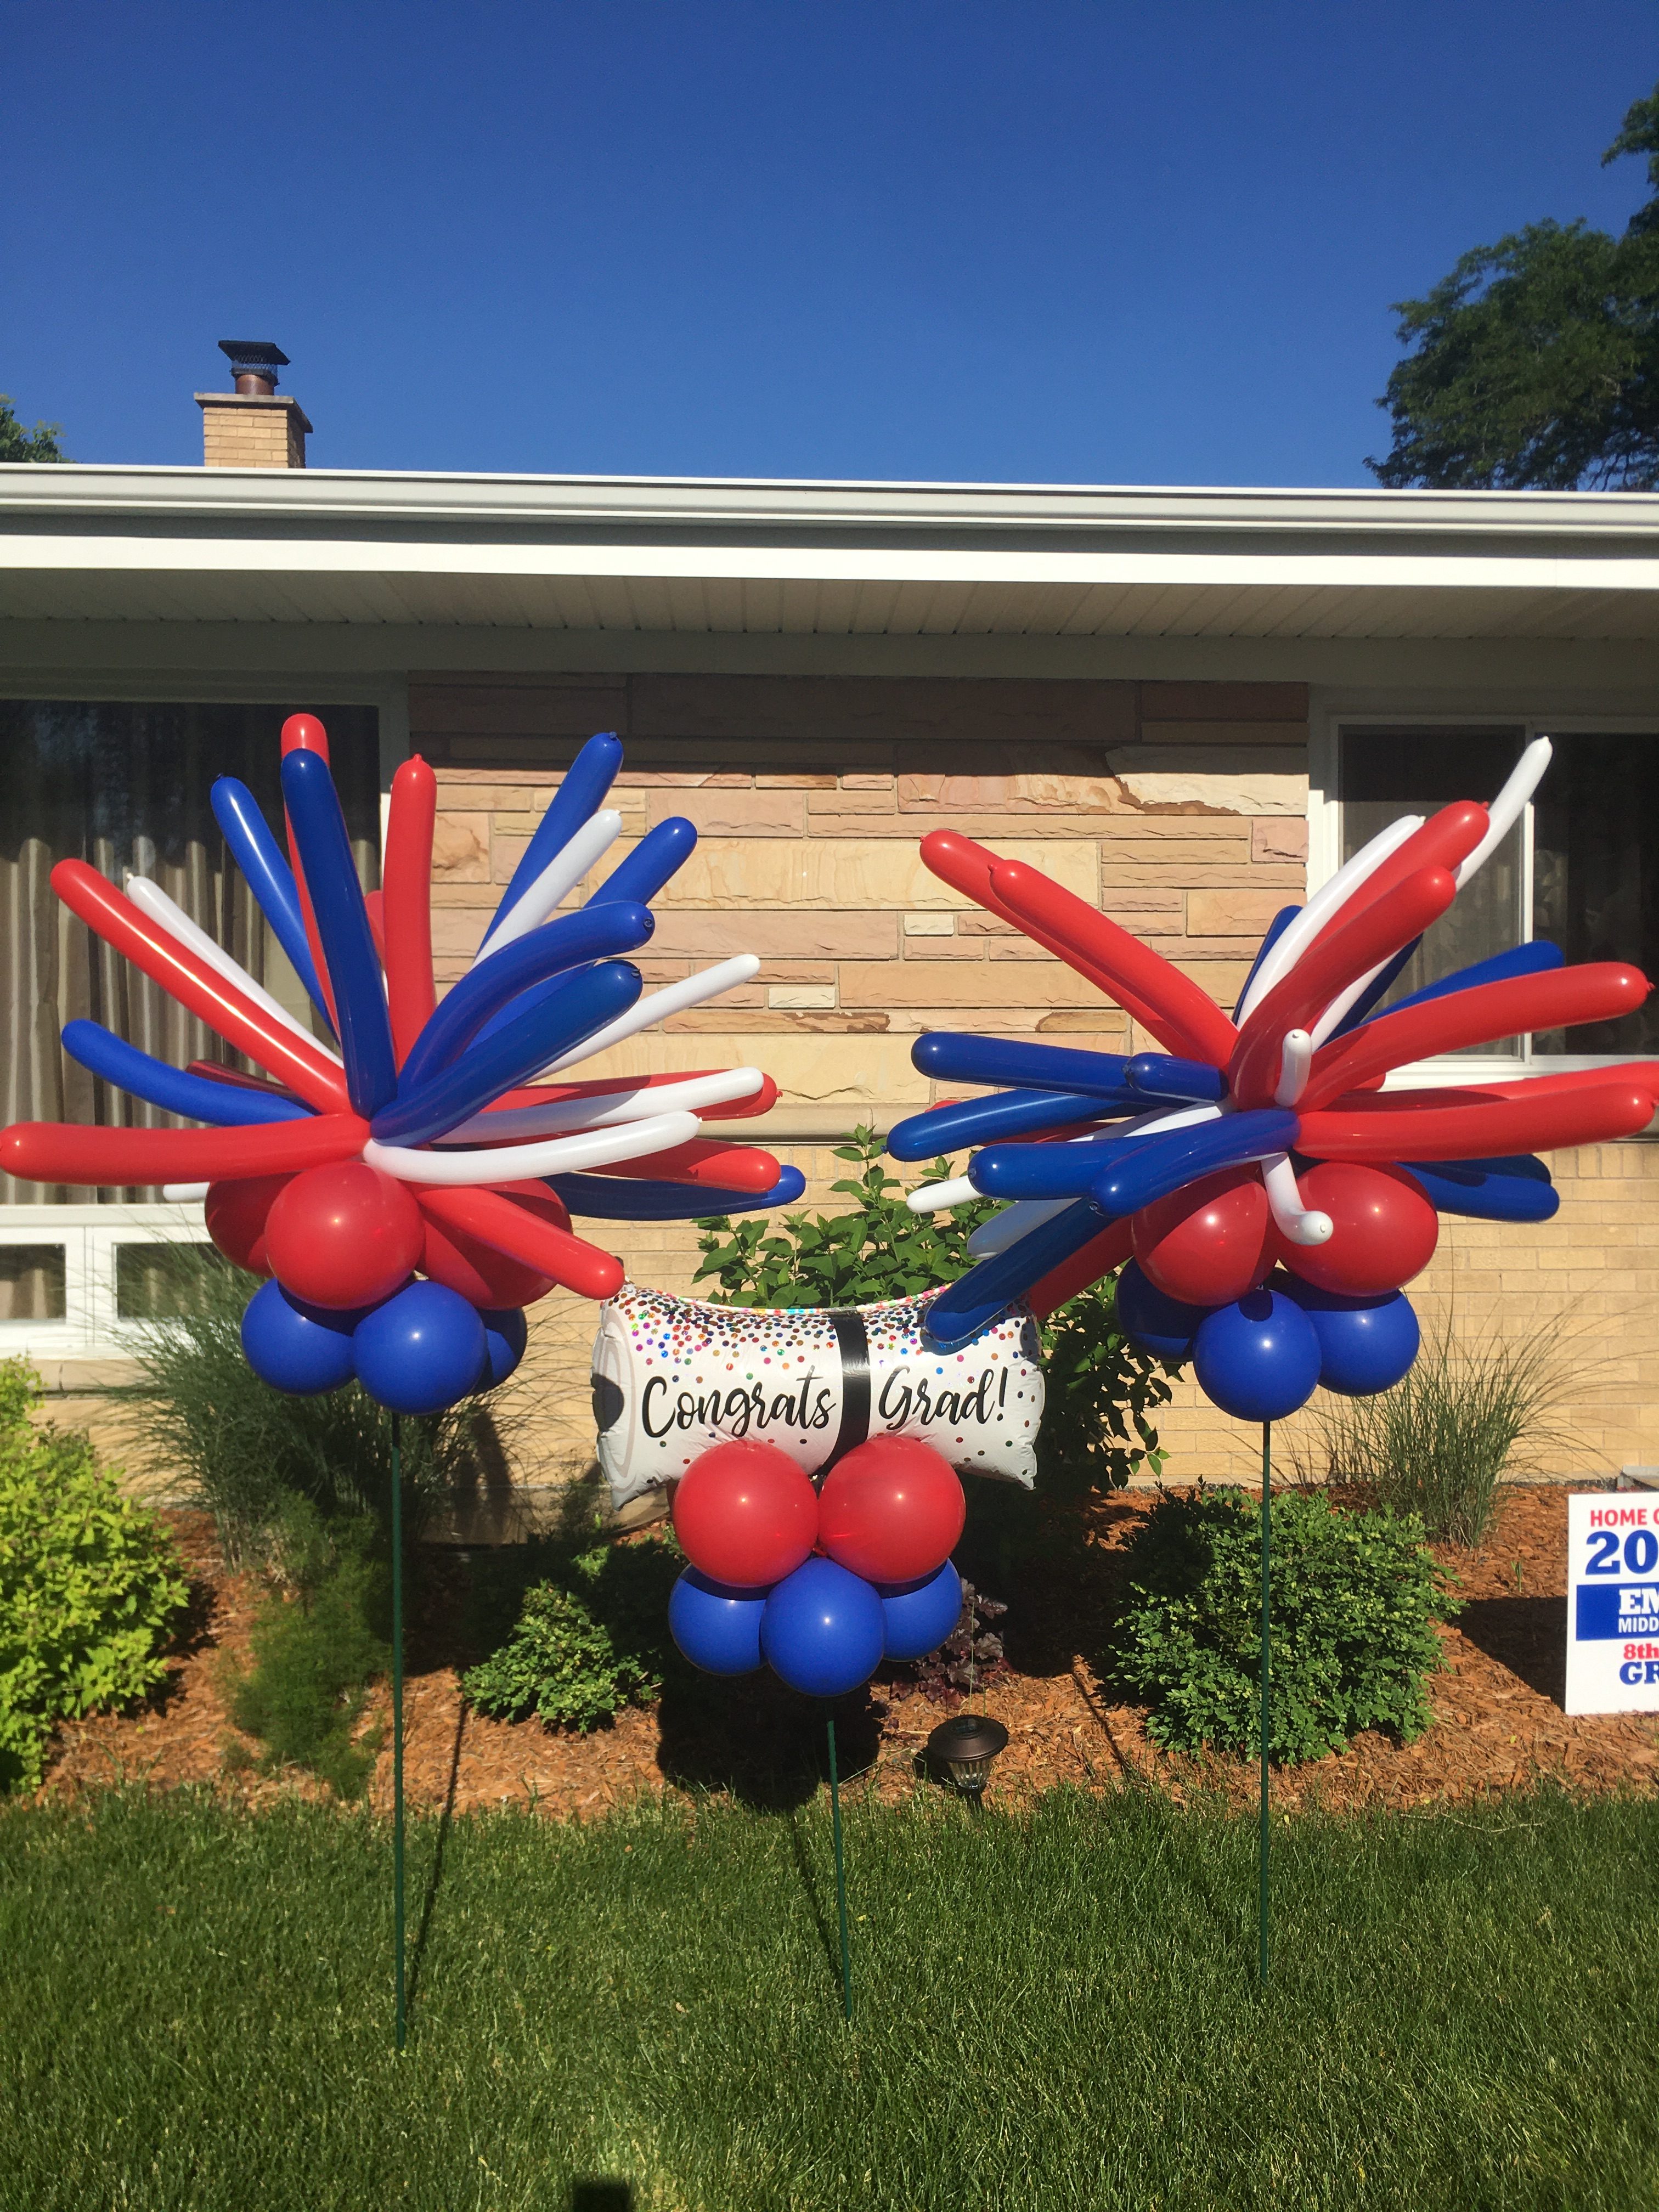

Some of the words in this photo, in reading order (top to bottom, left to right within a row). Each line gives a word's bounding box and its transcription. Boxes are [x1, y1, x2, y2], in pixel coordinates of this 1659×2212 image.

[642, 1365, 837, 1438] Congrats
[878, 1365, 1008, 1430] Grad!
[1590, 1508, 1647, 1527] HOME
[1623, 1643, 1659, 1660] 8th
